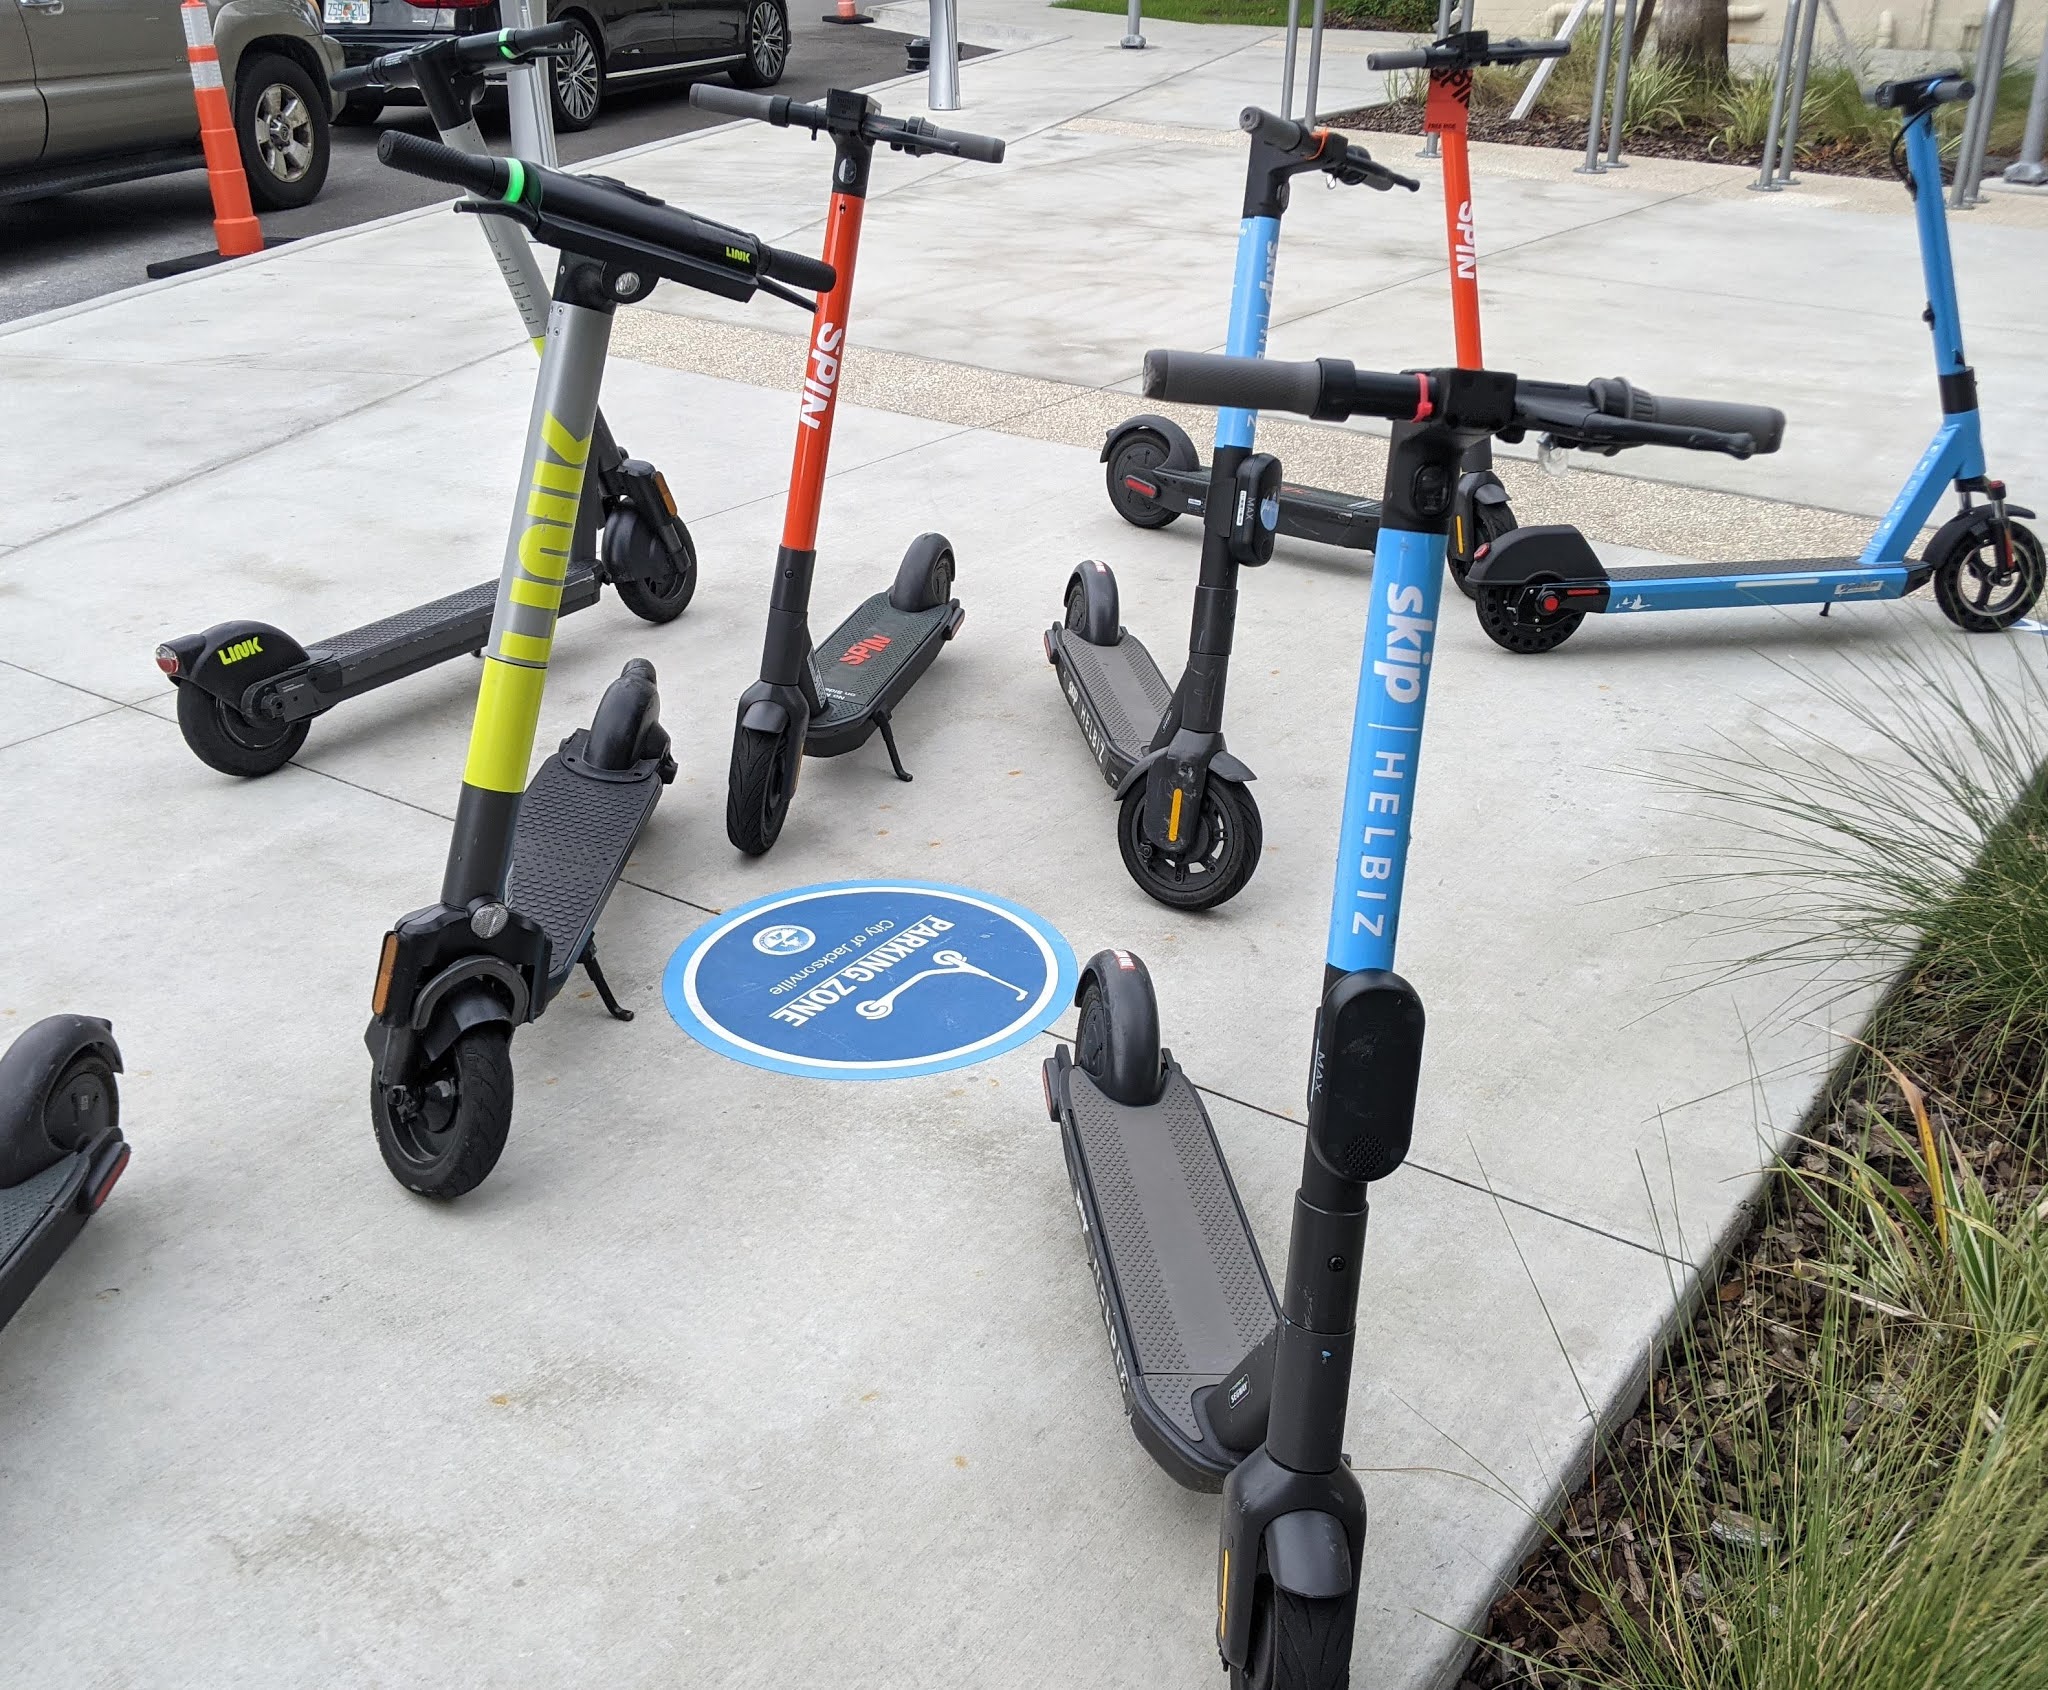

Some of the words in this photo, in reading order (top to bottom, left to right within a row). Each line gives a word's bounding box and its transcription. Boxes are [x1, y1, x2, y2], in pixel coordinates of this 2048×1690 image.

[726, 246, 750, 264] LINK
[1456, 201, 1475, 279] SPIN
[800, 322, 842, 429] SPIN
[1245, 497, 1256, 520] MAX
[499, 409, 592, 662] LINK
[218, 636, 263, 665] LINK
[839, 634, 892, 666] SPIN
[1374, 582, 1433, 703] skip
[1080, 704, 1106, 764] HELBIZ
[1352, 751, 1406, 937] HELBIZ
[841, 916, 956, 982] PARKING
[850, 935, 867, 948] of
[865, 920, 895, 936] City
[769, 943, 853, 995] Jacksonville
[771, 977, 858, 1027] ZONE
[1315, 1051, 1326, 1094] MAX
